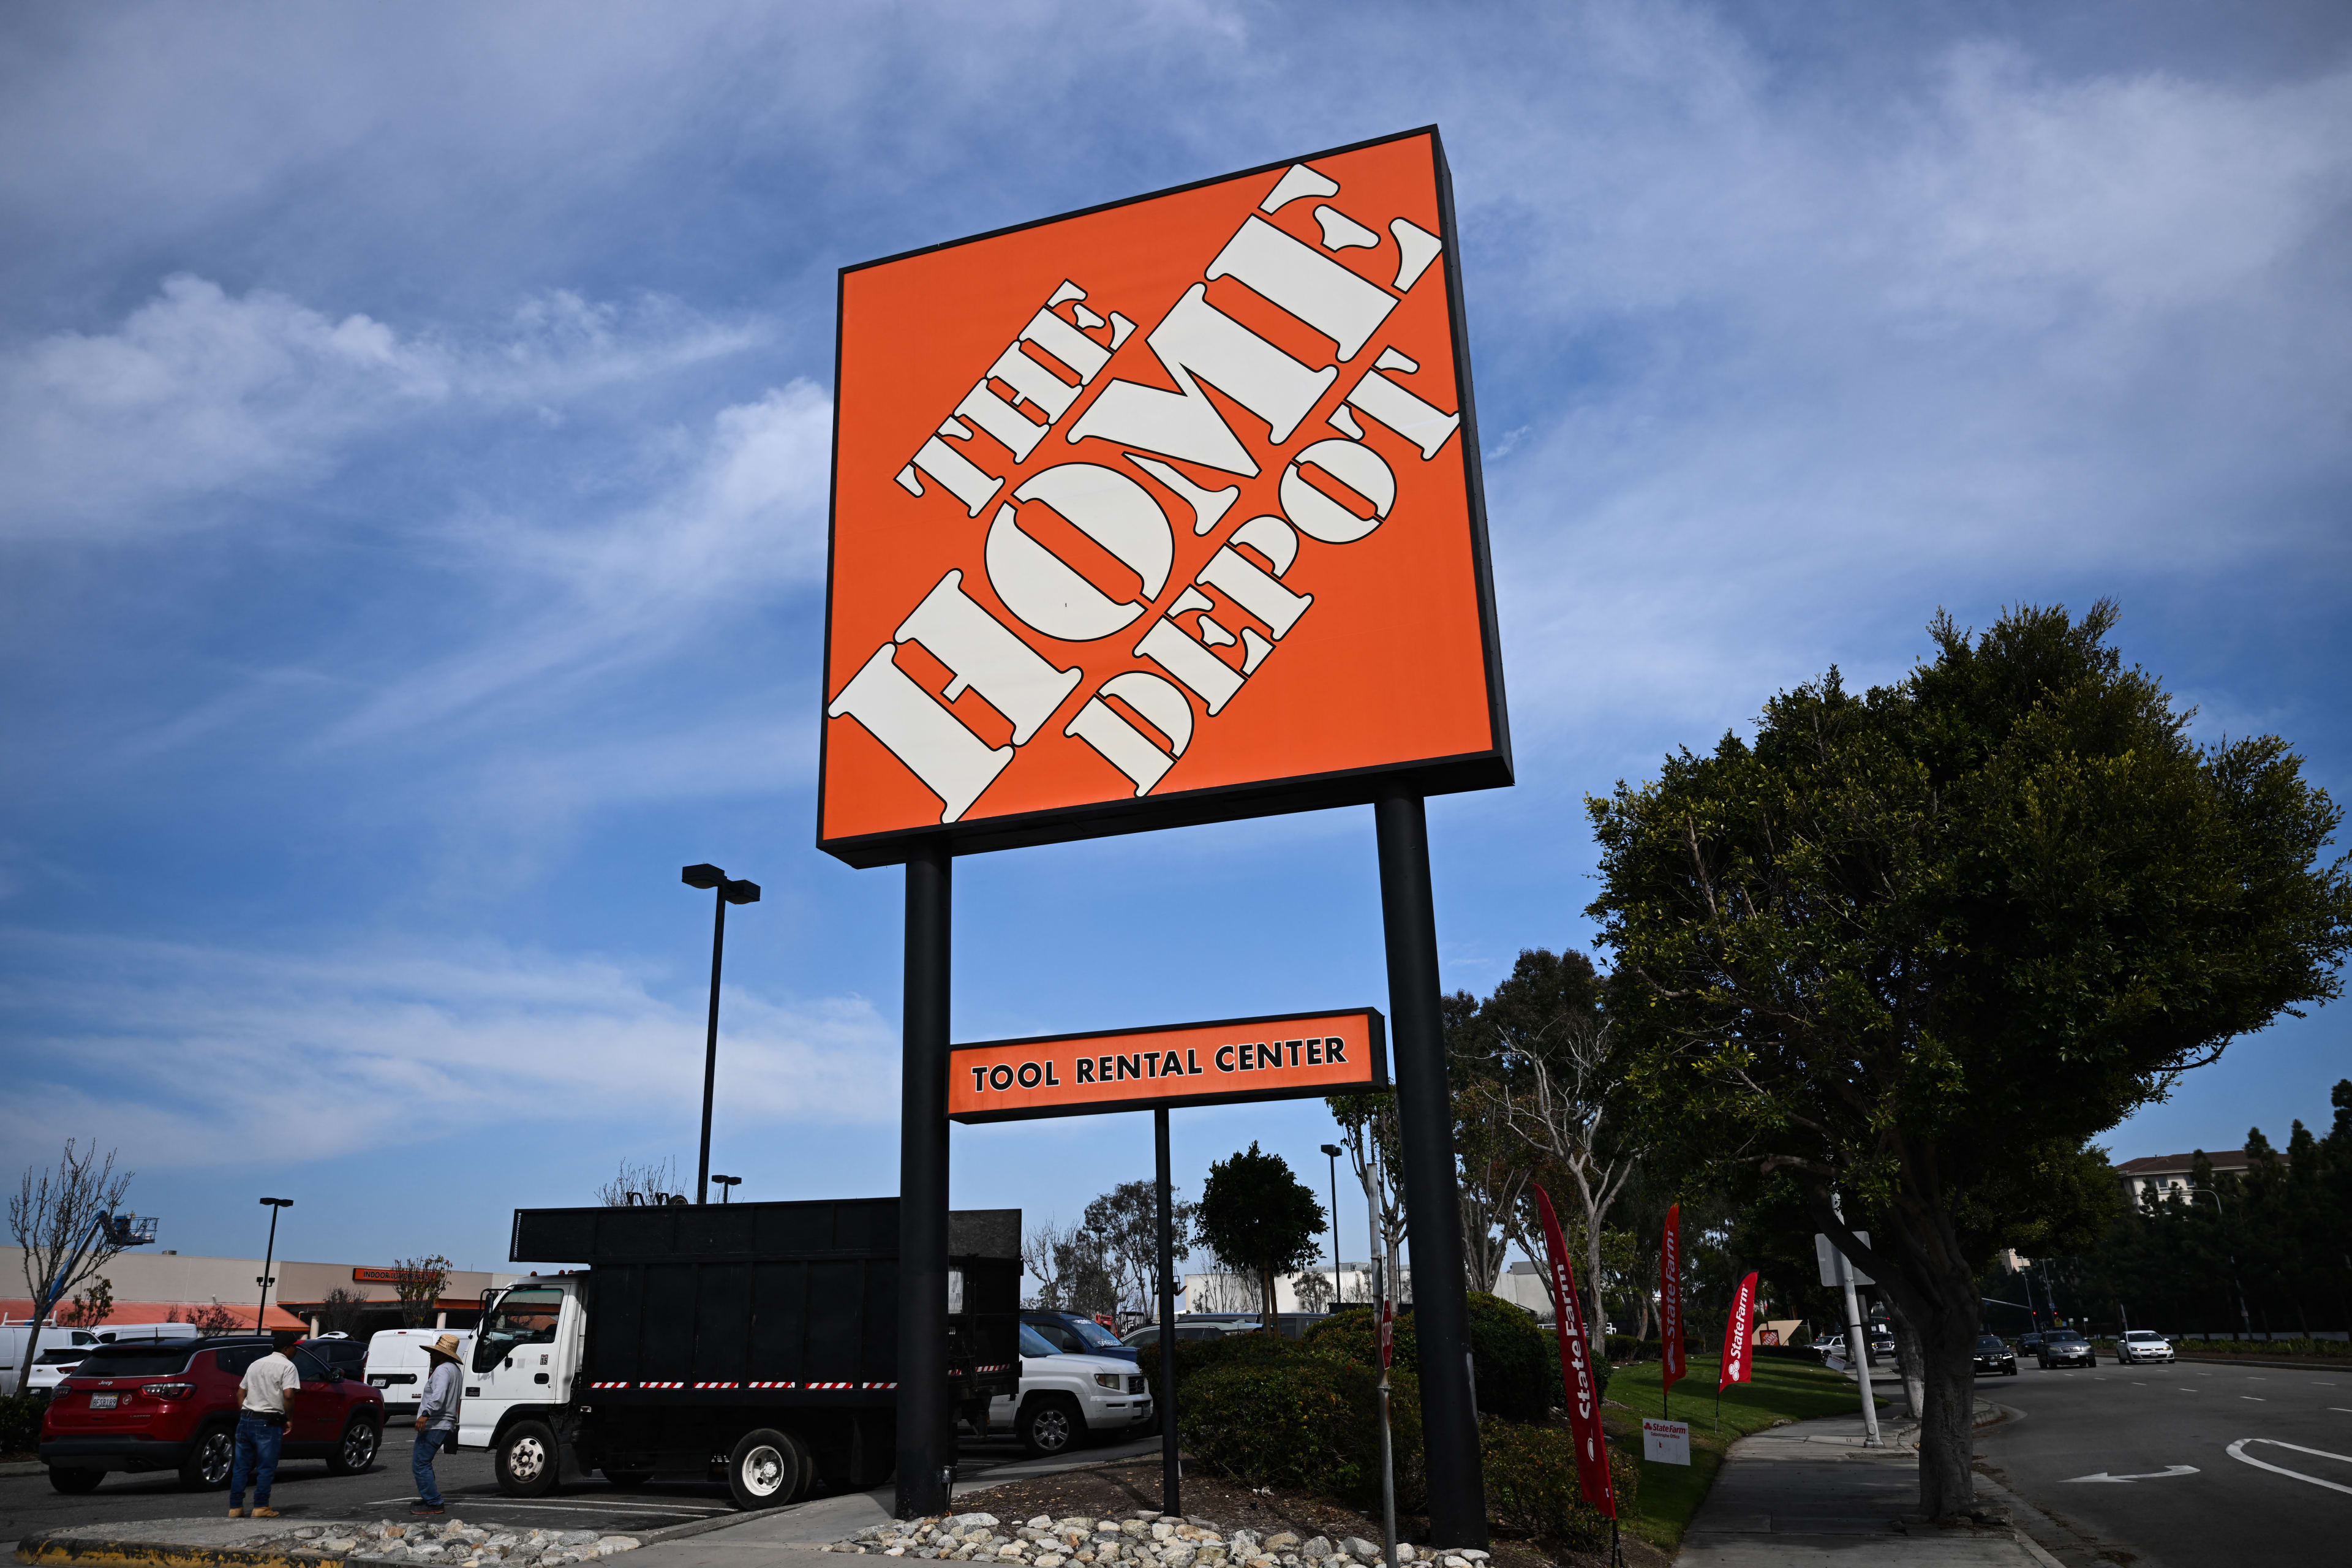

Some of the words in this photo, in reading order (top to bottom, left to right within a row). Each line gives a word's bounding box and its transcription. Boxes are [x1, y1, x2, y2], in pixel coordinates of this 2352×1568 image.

[894, 279, 1139, 519] THE
[827, 162, 1444, 825] HOME
[1063, 345, 1462, 798] DEPOT
[971, 1060, 1060, 1093] TOOL
[1076, 1048, 1203, 1085] RENTAL
[1214, 1036, 1349, 1073] CENTER
[363, 1271, 390, 1280] INDOOR
[1736, 1287, 1748, 1323] Farm
[1382, 1321, 1392, 1348] STOP
[1731, 1322, 1744, 1359] State
[1653, 1423, 1669, 1433] State
[1669, 1425, 1686, 1434] Farm
